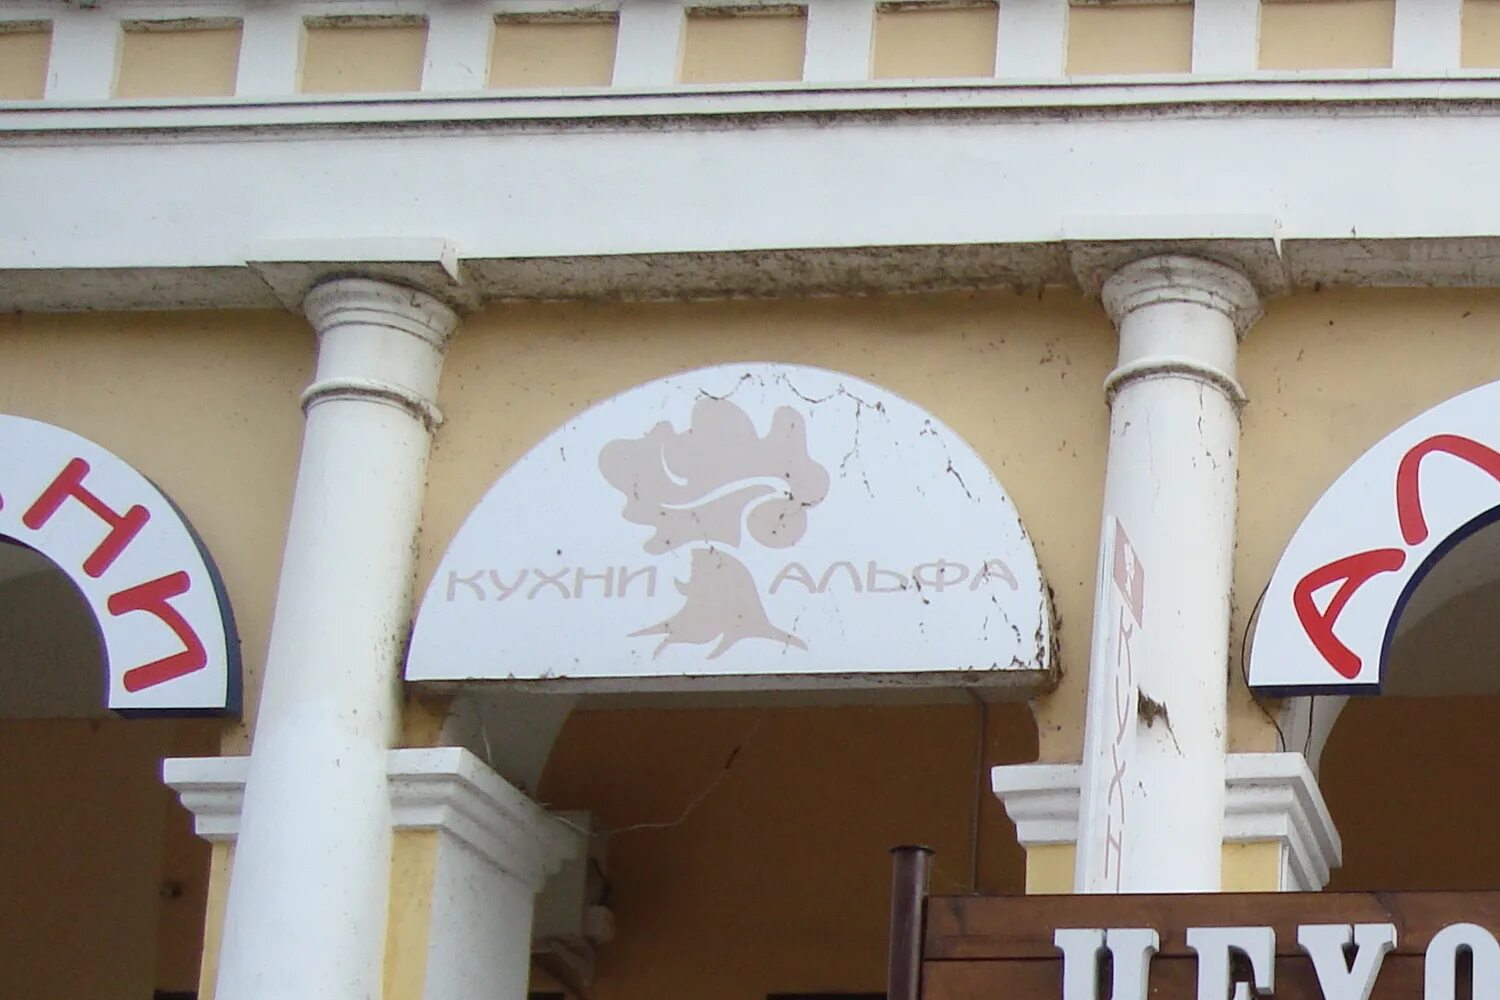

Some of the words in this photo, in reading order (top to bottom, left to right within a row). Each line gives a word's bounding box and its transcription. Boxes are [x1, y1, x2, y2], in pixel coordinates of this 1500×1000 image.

[0, 457, 207, 693] НИ
[446, 563, 659, 602] КУХНИ
[768, 558, 1020, 594] АЛЬФА
[1105, 605, 1134, 893] КУХН
